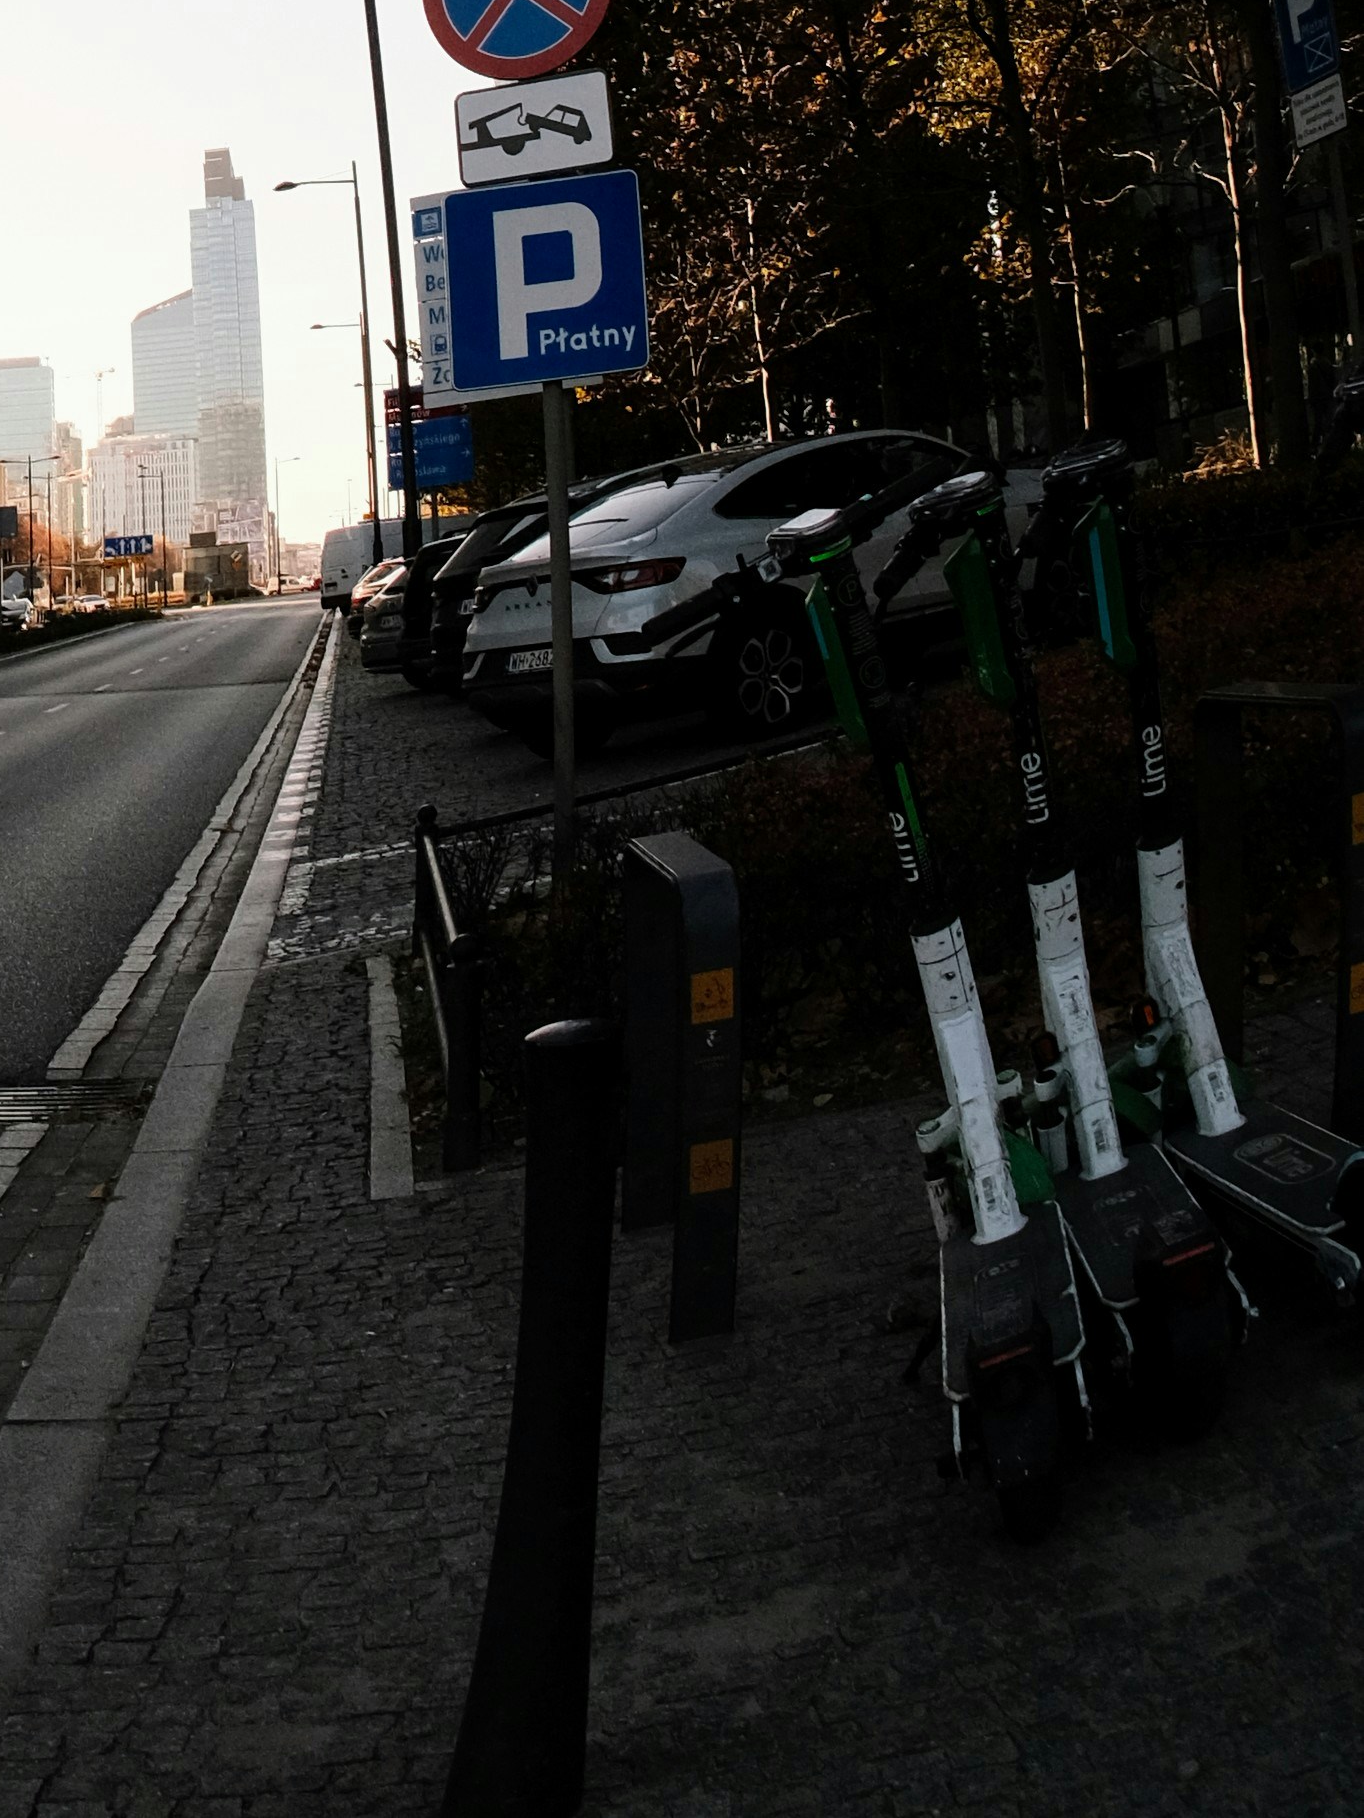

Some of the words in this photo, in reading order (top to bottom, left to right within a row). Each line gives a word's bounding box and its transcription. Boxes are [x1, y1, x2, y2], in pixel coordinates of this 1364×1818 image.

[492, 201, 603, 361] P
[539, 323, 636, 356] Płatny
[1020, 752, 1050, 825] Lime
[1141, 724, 1167, 798] Lime
